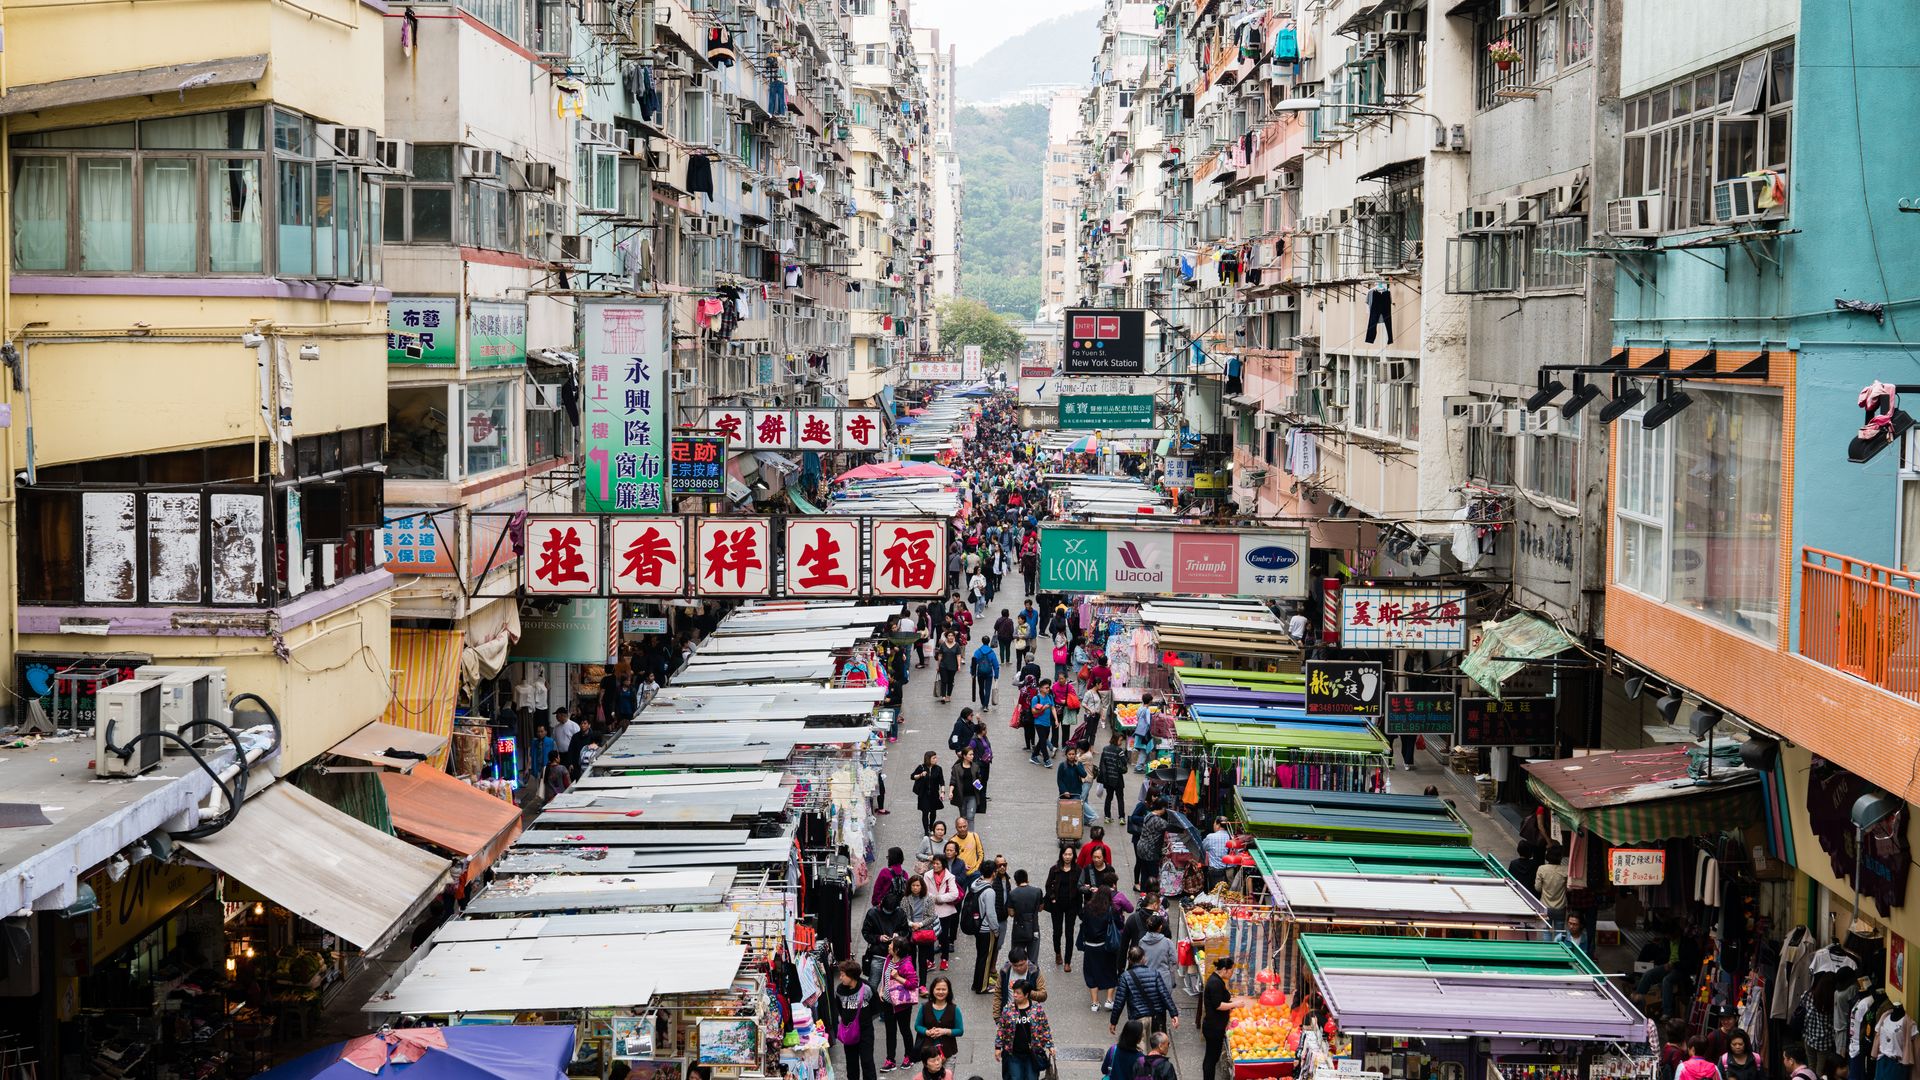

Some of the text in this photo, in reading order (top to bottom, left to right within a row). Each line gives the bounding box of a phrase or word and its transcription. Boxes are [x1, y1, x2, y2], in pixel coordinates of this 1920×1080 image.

[403, 309, 440, 328] 布藝
[1072, 359, 1138, 367] New York Station
[591, 364, 609, 439] 請上一樓
[624, 357, 651, 447] 永興隆
[671, 443, 717, 462] 足跡
[1302, 434, 1310, 470] PACIFIC
[672, 478, 720, 489] 23938698
[1251, 554, 1295, 564] Embry Form
[1050, 558, 1099, 582] LEONA
[1186, 559, 1227, 573] Triumph
[1115, 570, 1163, 582] Wacoal
[1255, 575, 1289, 584] 安莉芳
[521, 620, 593, 631] PROFESSIONAL
[1365, 704, 1379, 713] 1/F
